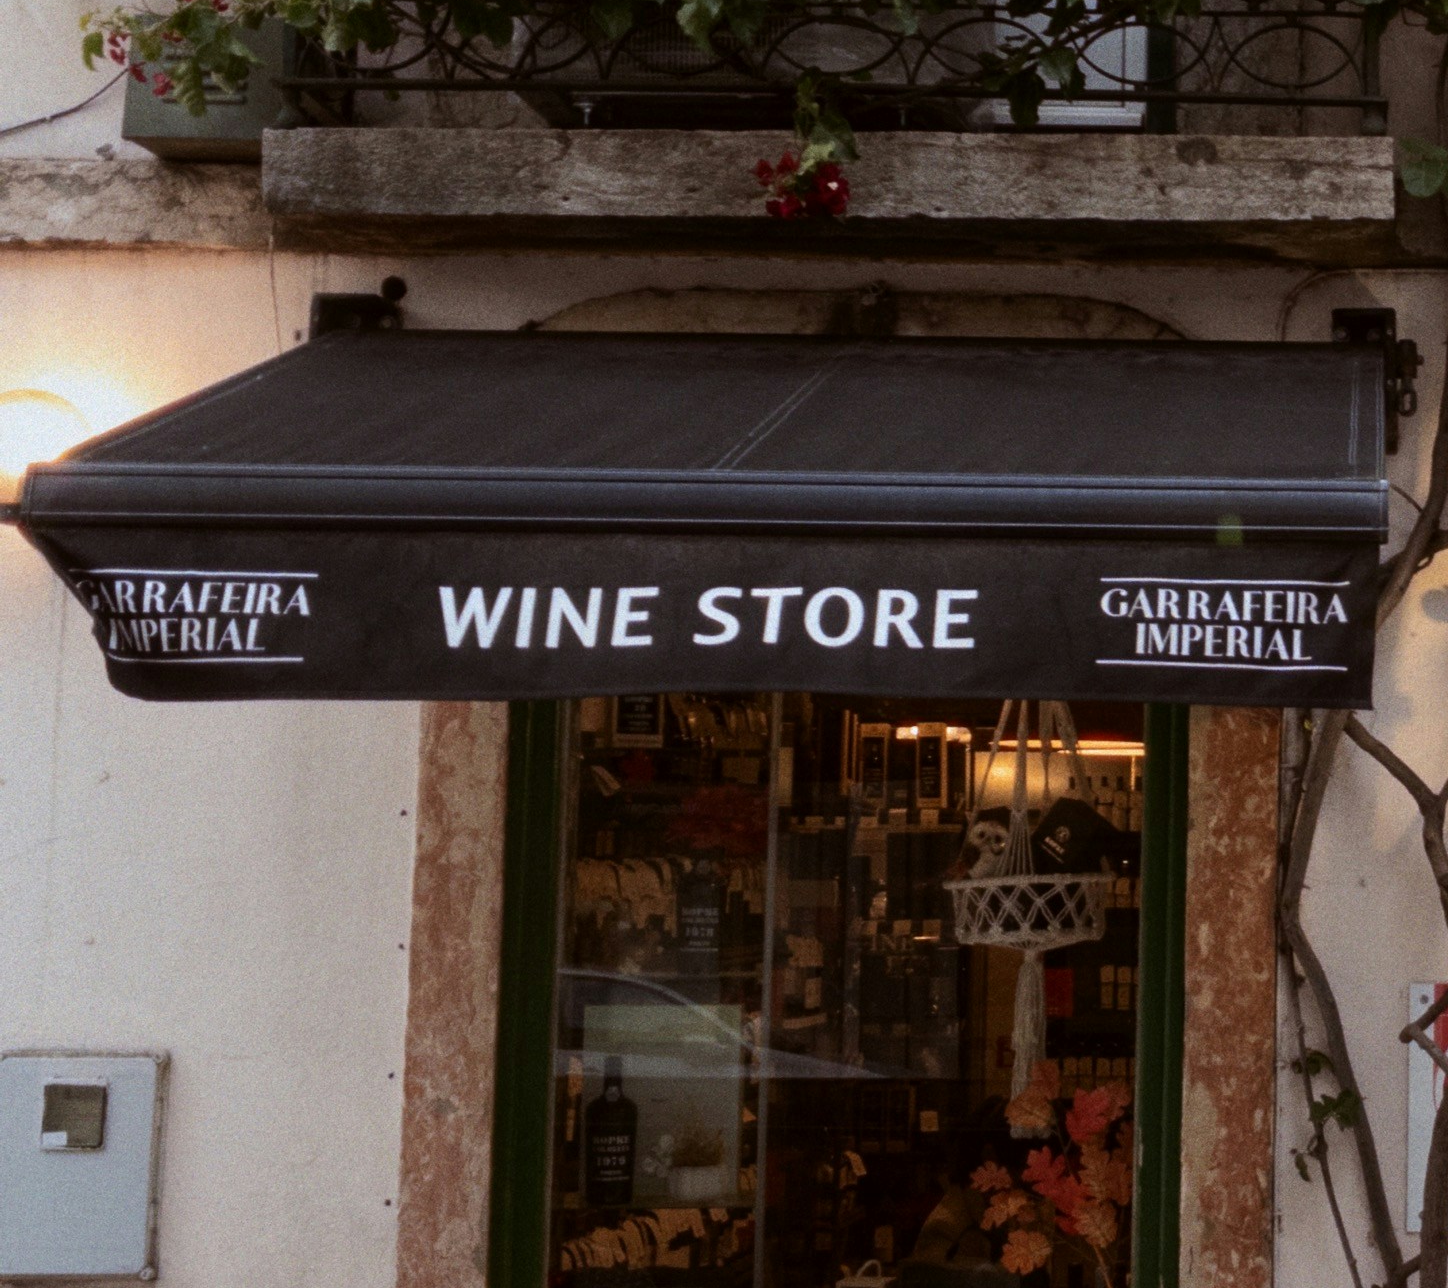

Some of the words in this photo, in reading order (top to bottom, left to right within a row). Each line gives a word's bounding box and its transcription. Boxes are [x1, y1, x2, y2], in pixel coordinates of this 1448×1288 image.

[76, 579, 311, 615] GARRAFEIRA
[1100, 587, 1349, 625] GARRAFEIRA
[108, 617, 266, 652] IMPERIAL
[438, 586, 660, 649] WINE
[692, 586, 979, 649] STORE
[1135, 622, 1313, 661] IMPERIAL
